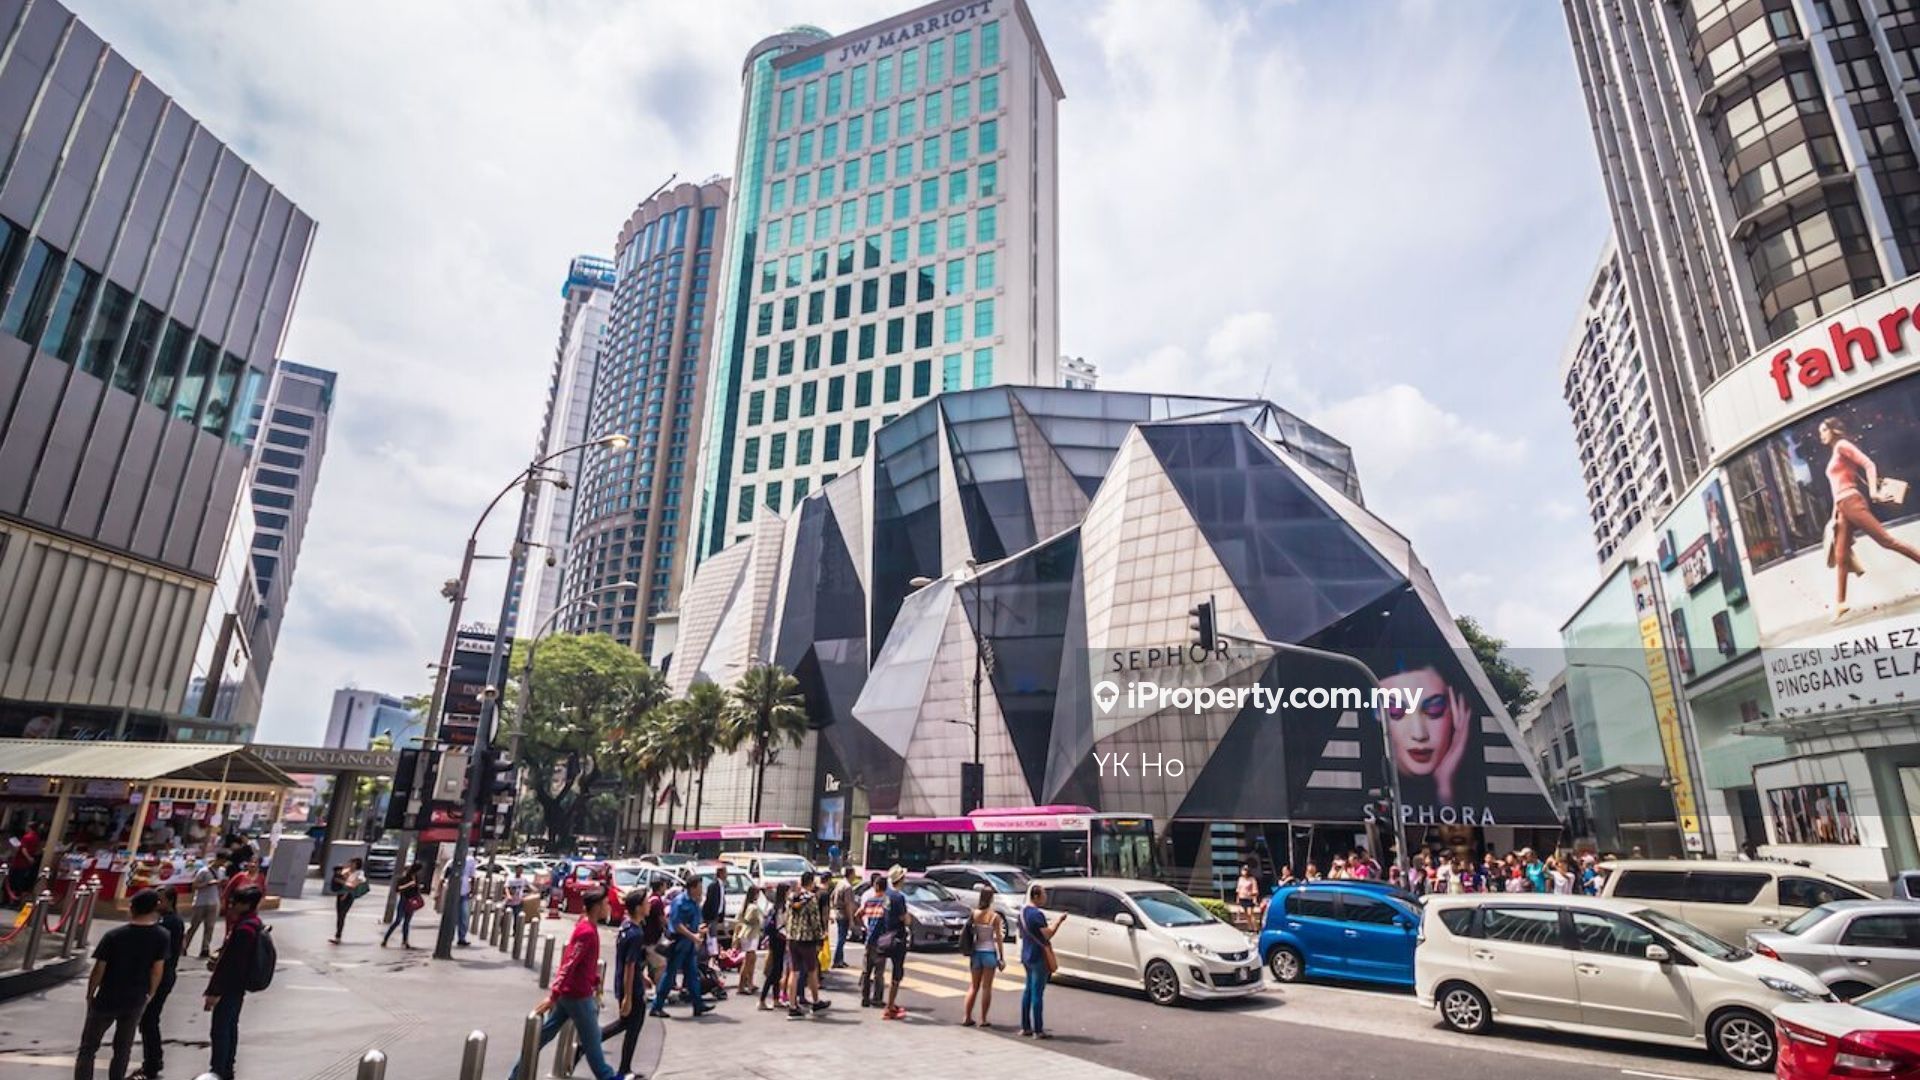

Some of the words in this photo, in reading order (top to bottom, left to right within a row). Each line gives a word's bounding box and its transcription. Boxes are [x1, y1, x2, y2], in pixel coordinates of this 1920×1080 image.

[839, 40, 871, 62] JW
[877, 0, 993, 50] MARRIOTT
[1112, 640, 1243, 672] SEPHOR
[1771, 647, 1823, 675] KOLEKSI
[1831, 636, 1879, 662] JEAN
[1887, 627, 1920, 650] EZ
[1775, 662, 1864, 700] PINGGANG
[298, 752, 371, 765] BINTANG
[1363, 803, 1496, 826] SPHORA
